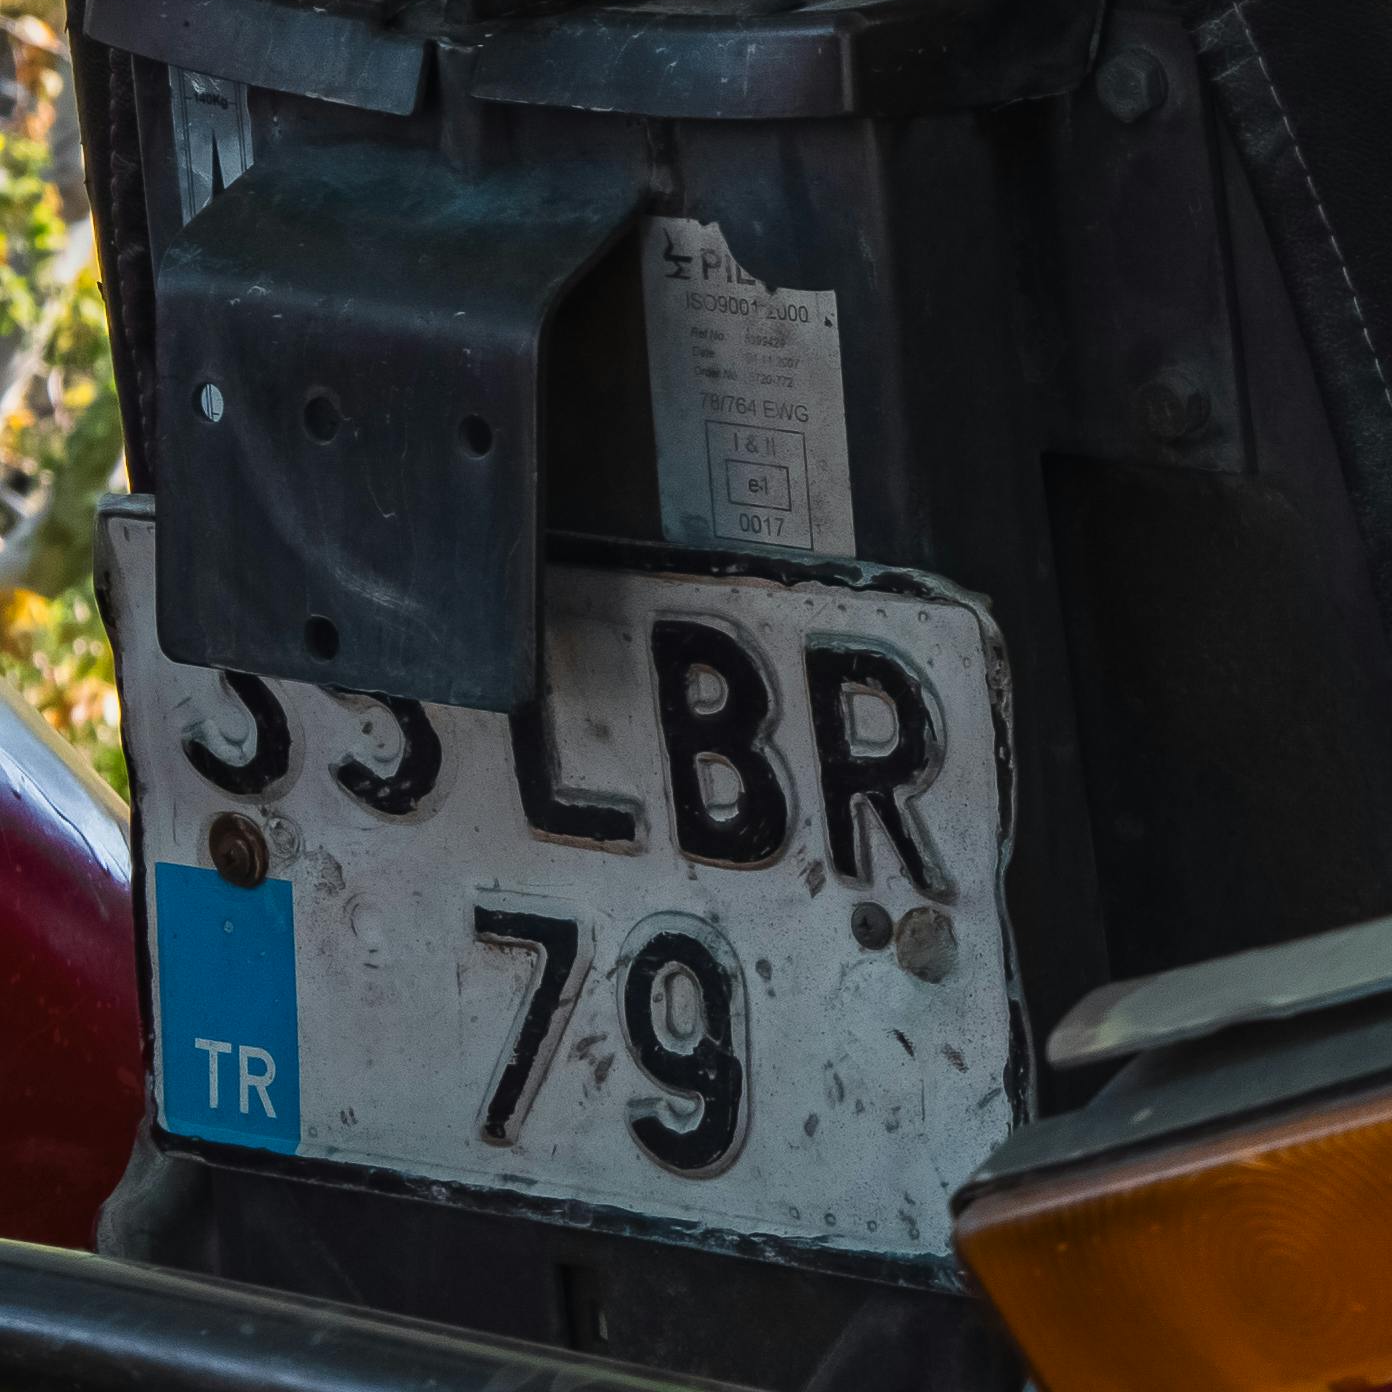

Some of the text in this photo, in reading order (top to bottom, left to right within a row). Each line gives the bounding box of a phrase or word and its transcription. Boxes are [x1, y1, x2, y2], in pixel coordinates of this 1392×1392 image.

[700, 392, 809, 422] 78/764 EWG
[745, 435, 759, 454] &
[739, 513, 784, 536] 0017
[510, 619, 953, 900] LBR
[473, 905, 744, 1171] 79
[194, 1036, 276, 1120] TR
